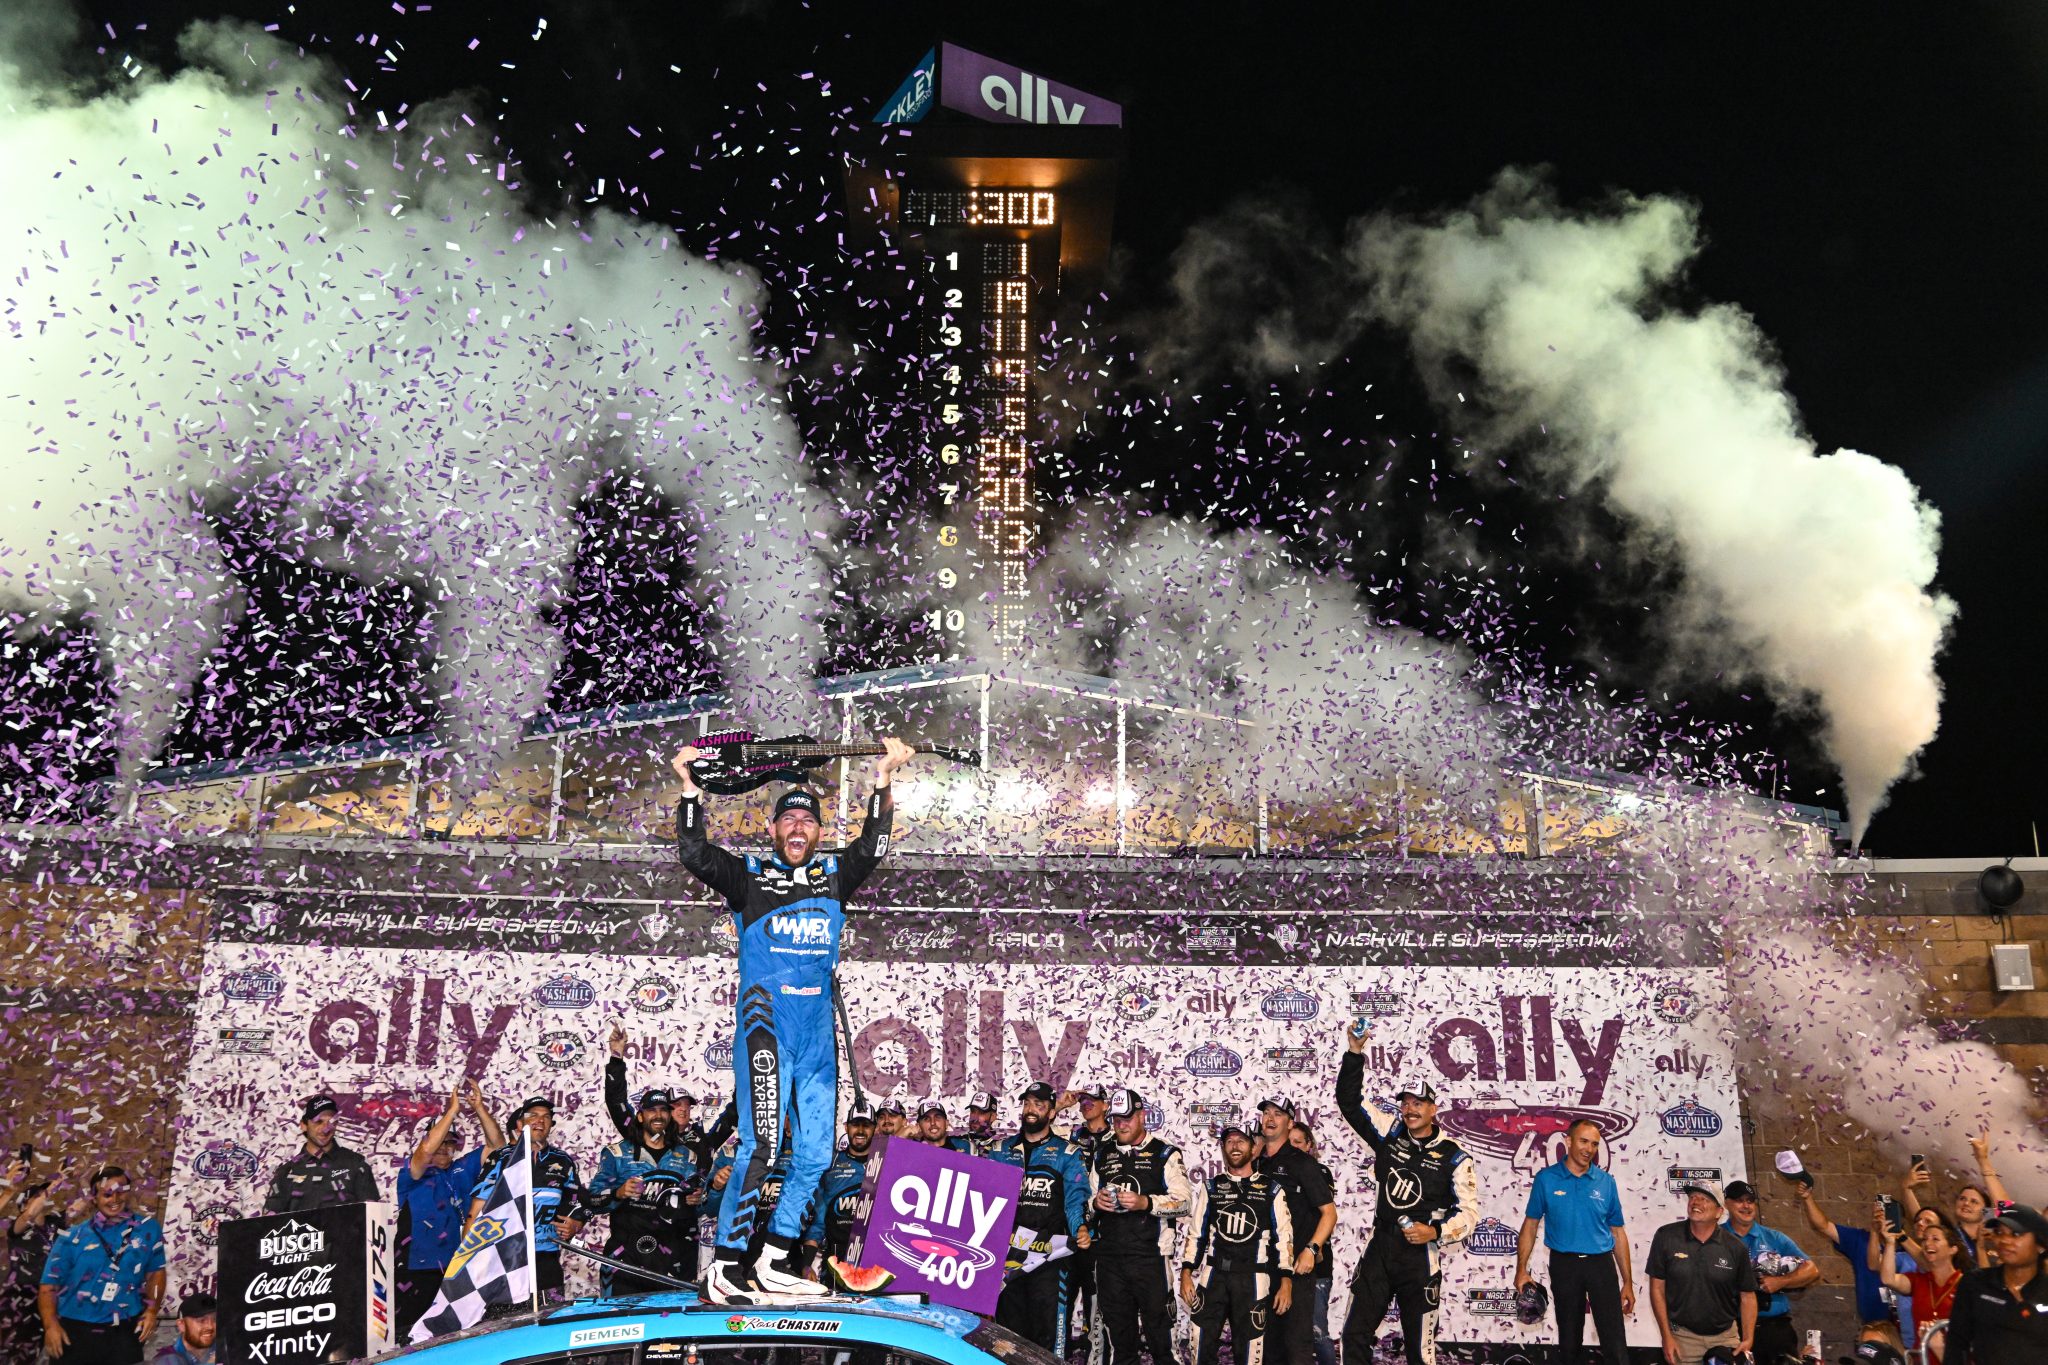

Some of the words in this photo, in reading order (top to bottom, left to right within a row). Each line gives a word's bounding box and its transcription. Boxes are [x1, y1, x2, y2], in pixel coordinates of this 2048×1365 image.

[980, 72, 1085, 124] ally
[946, 252, 958, 271] 1
[944, 289, 963, 308] 2
[996, 281, 1027, 313] 19
[944, 327, 962, 346] 3
[995, 318, 1026, 351] 11
[943, 366, 961, 384] 4
[942, 404, 960, 424] 5
[941, 444, 960, 464] 6
[939, 484, 959, 504] 7
[979, 478, 1025, 511] 20
[938, 568, 957, 588] 9
[930, 610, 965, 631] 10
[691, 731, 752, 747] NASHVILLE
[792, 935, 831, 945] RACING
[988, 932, 1065, 948] GEICO
[1325, 932, 1447, 947] NASHVILLE
[710, 982, 737, 1006] al
[1187, 990, 1237, 1018] ally
[1267, 1000, 1314, 1013] NASHVILLE
[237, 1031, 265, 1040] NASCAR
[309, 978, 517, 1091] ally
[853, 990, 1092, 1097] ally
[623, 1036, 675, 1066] ally
[1429, 995, 1625, 1105] ally
[1655, 1048, 1708, 1080] ally
[754, 1075, 768, 1136] EXPRESS
[1666, 1116, 1717, 1129] NASHVILLE
[866, 1151, 883, 1183] ally
[1189, 1161, 1222, 1184] all
[1687, 1170, 1713, 1178] NASCAR
[1024, 1190, 1051, 1198] ACING
[856, 1193, 873, 1226] ally
[890, 1168, 1008, 1248] ally
[259, 1230, 324, 1260] BUSCH
[372, 1220, 387, 1278] 75
[846, 1235, 863, 1268] ally
[1010, 1233, 1028, 1248] LY
[1467, 1234, 1518, 1248] NASHVILLE
[273, 1252, 310, 1265] LIGHT
[919, 1253, 976, 1289] 400
[244, 1263, 337, 1304] Coca-Cola
[244, 1302, 336, 1331] GEICO
[744, 1318, 777, 1329] Ross
[777, 1319, 840, 1332] CHASTAIN
[574, 1326, 640, 1342] SIEMENS
[248, 1330, 331, 1365] xfinity
